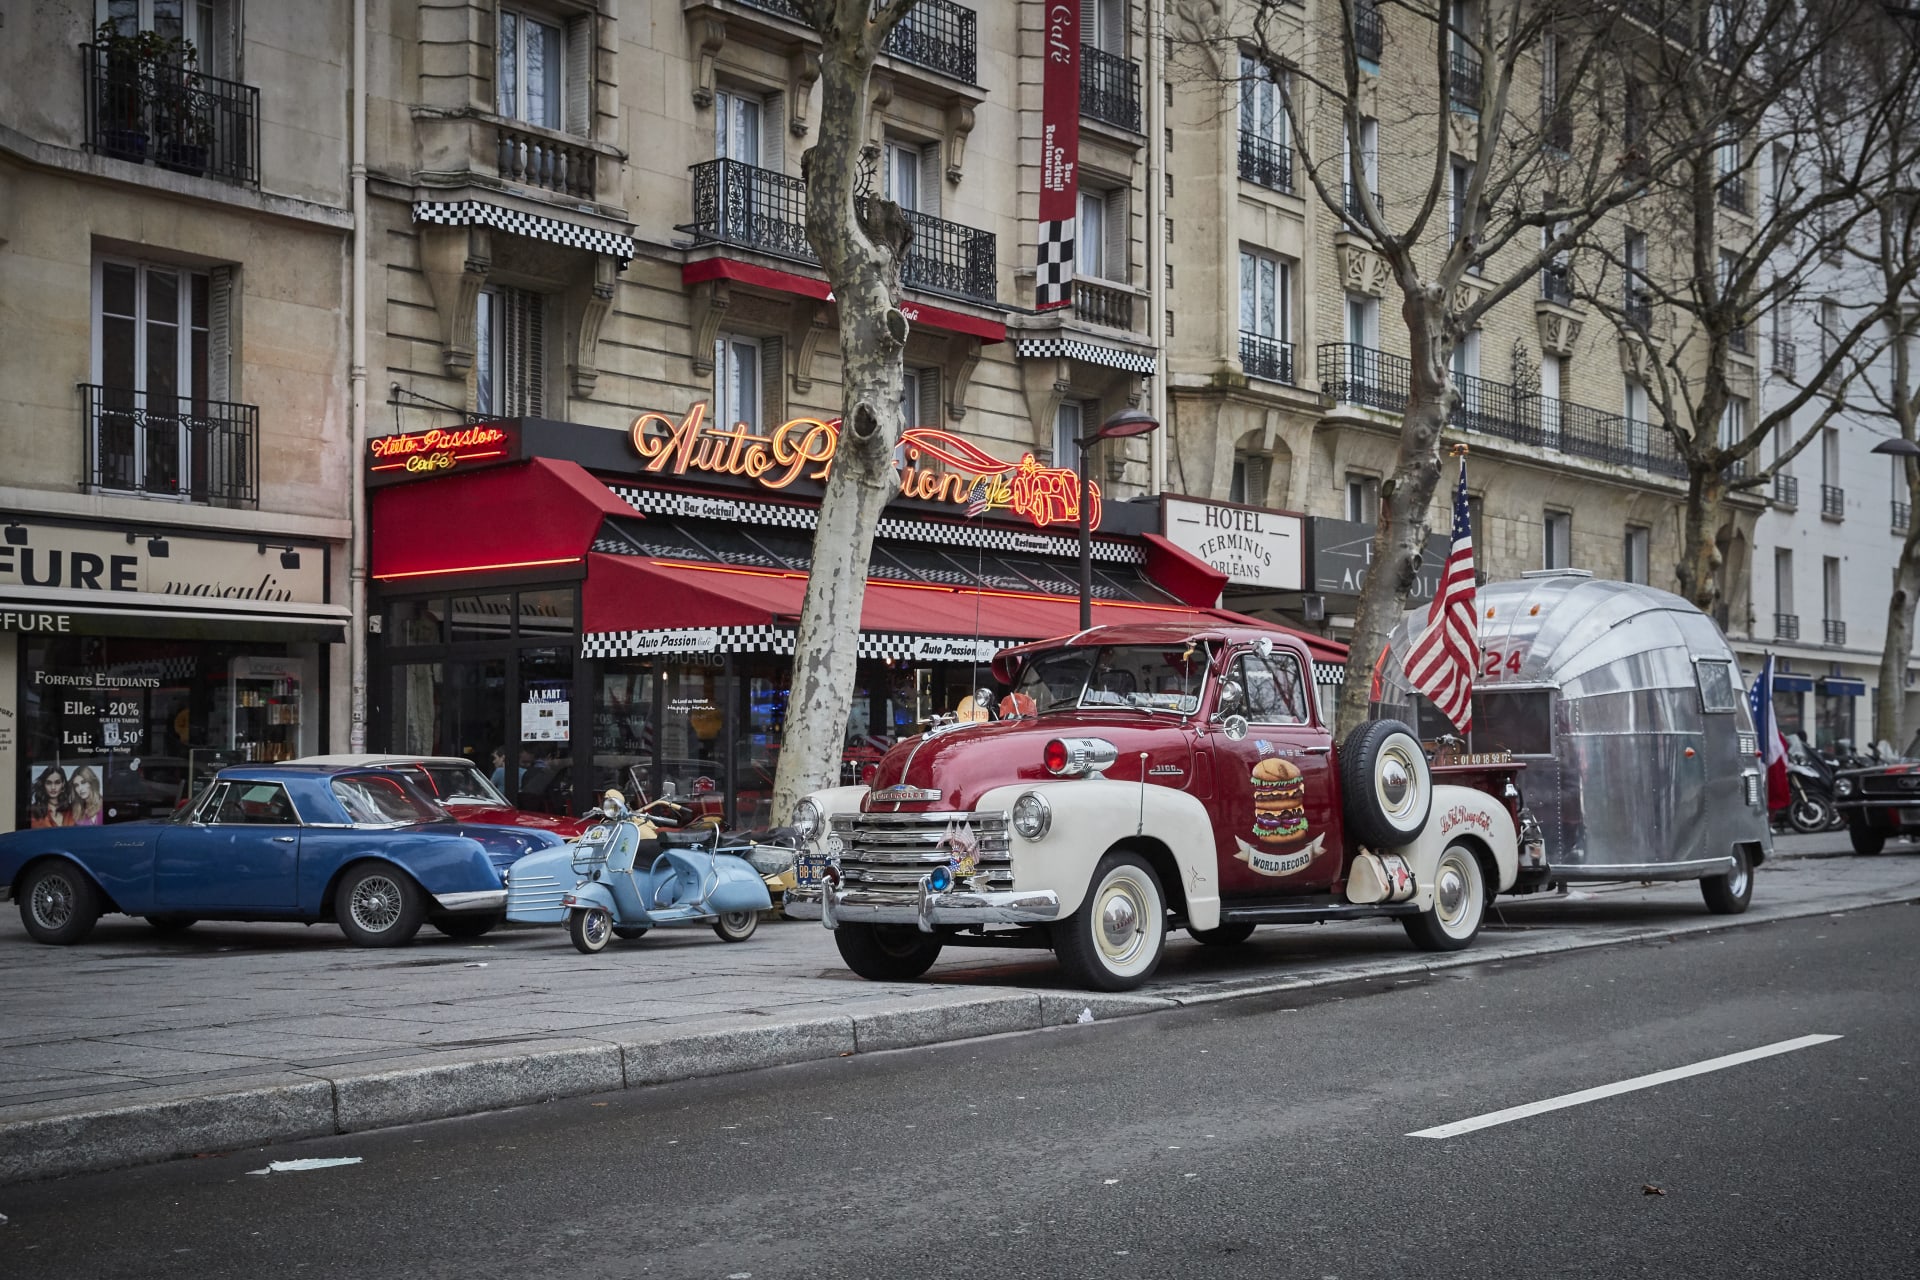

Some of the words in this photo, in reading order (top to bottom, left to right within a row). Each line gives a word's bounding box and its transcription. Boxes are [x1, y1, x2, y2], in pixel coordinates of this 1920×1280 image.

[1050, 4, 1073, 65] Café
[1044, 124, 1056, 190] Restaurant
[1054, 147, 1065, 193] Cocktail
[1064, 162, 1074, 184] Bar
[371, 434, 418, 458] Auto
[416, 426, 503, 452] Passion
[630, 400, 775, 479] Auto
[759, 417, 970, 505] Pion
[405, 451, 450, 473] Café
[683, 501, 701, 515] Bar
[702, 503, 736, 519] Cocktail
[1205, 506, 1264, 534] HOTEL
[1014, 537, 1049, 553] Restaurant
[1199, 534, 1272, 567] TERMINUS
[163, 574, 294, 603] masculin
[0, 612, 71, 633] FURE
[636, 636, 659, 649] Auto
[660, 634, 697, 648] Passion
[919, 642, 943, 656] Auto
[944, 643, 977, 657] Passion
[1485, 651, 1523, 676] 24
[35, 671, 92, 686] FORFAITS
[95, 673, 161, 688] ETUDIANTS
[541, 688, 562, 700] KART
[63, 701, 96, 715] Elle:
[109, 702, 140, 716] 20%
[63, 730, 93, 745] Lui:
[1155, 764, 1176, 772] 3100
[1460, 754, 1469, 765] 01
[1471, 754, 1481, 765] 40
[1483, 754, 1490, 764] 18
[1491, 753, 1500, 763] 92
[1501, 753, 1508, 763] 17
[1252, 855, 1280, 872] WORLD
[1281, 854, 1310, 872] RECORD
